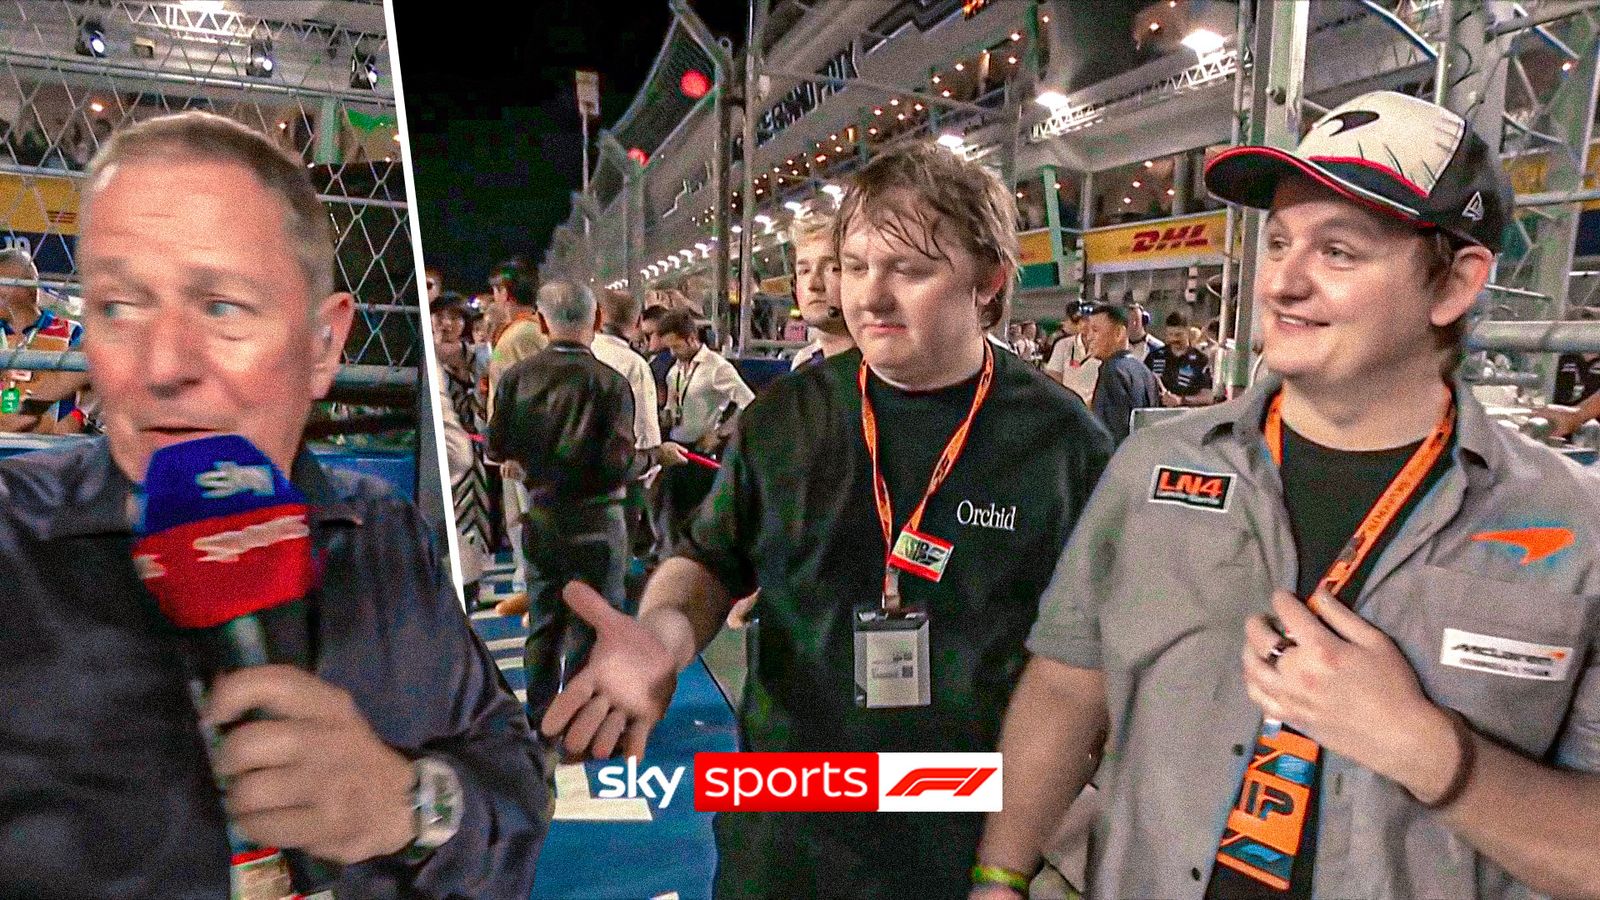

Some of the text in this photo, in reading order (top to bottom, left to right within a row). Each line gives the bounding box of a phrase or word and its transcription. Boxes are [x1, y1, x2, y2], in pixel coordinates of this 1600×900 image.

[1132, 224, 1208, 252] DHL
[1159, 471, 1223, 497] LN4
[956, 500, 1017, 531] Orchid
